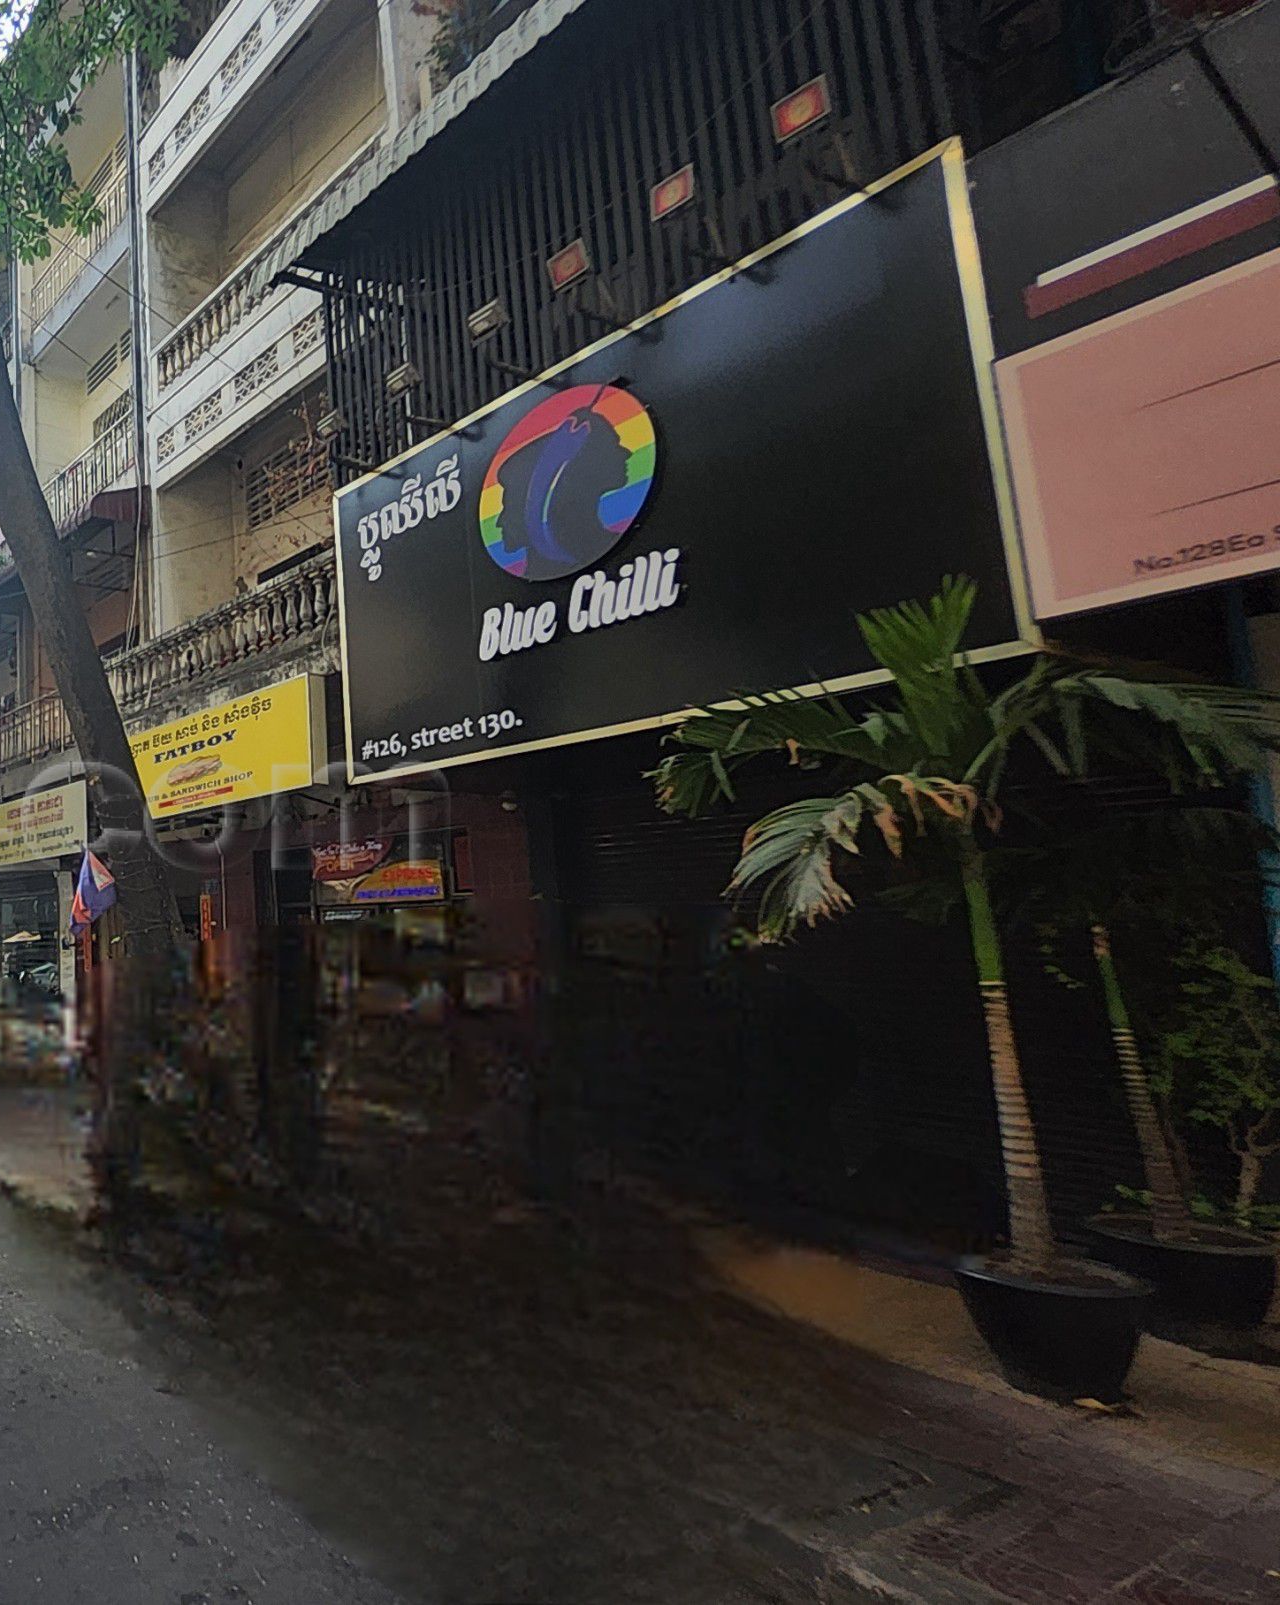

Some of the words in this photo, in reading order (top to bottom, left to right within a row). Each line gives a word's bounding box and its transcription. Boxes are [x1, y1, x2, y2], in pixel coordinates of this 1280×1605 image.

[478, 601, 558, 662] Blue
[567, 547, 681, 635] Chilli
[153, 728, 237, 764] FATBOY
[361, 736, 408, 762] #126,
[410, 715, 474, 751] street
[477, 709, 524, 739] 130.
[170, 778, 222, 797] SANDWICH
[223, 770, 254, 785] SHOP
